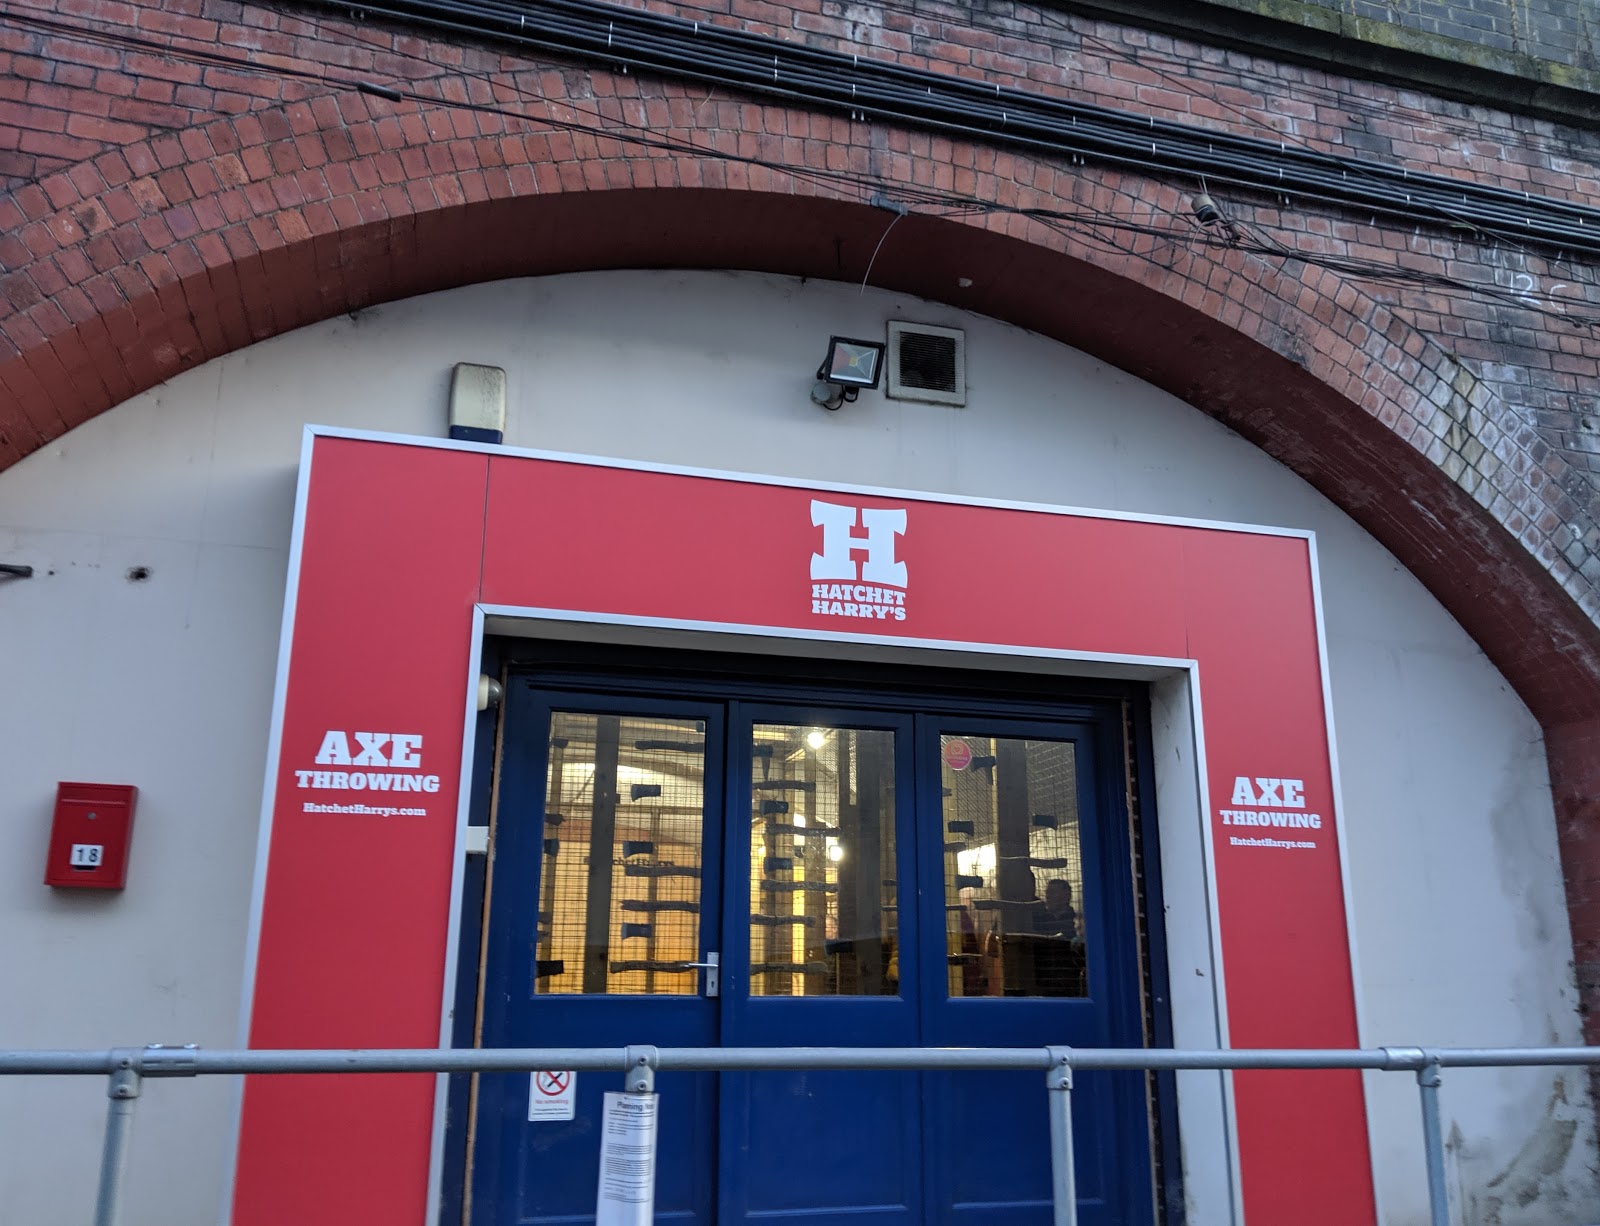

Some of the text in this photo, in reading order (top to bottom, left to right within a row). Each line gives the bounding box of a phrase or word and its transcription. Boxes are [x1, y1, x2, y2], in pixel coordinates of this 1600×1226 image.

[810, 499, 908, 589] H
[811, 583, 906, 606] HATCHET
[811, 599, 907, 621] HARRY'S
[314, 730, 423, 768] AXE
[295, 770, 440, 793] THROWING
[1231, 776, 1306, 808] AXE
[302, 802, 426, 817] HatchetHarrys.com
[1219, 809, 1322, 829] THROWING
[1229, 836, 1316, 849] HatchetHarrys.com
[76, 848, 99, 863] 18
